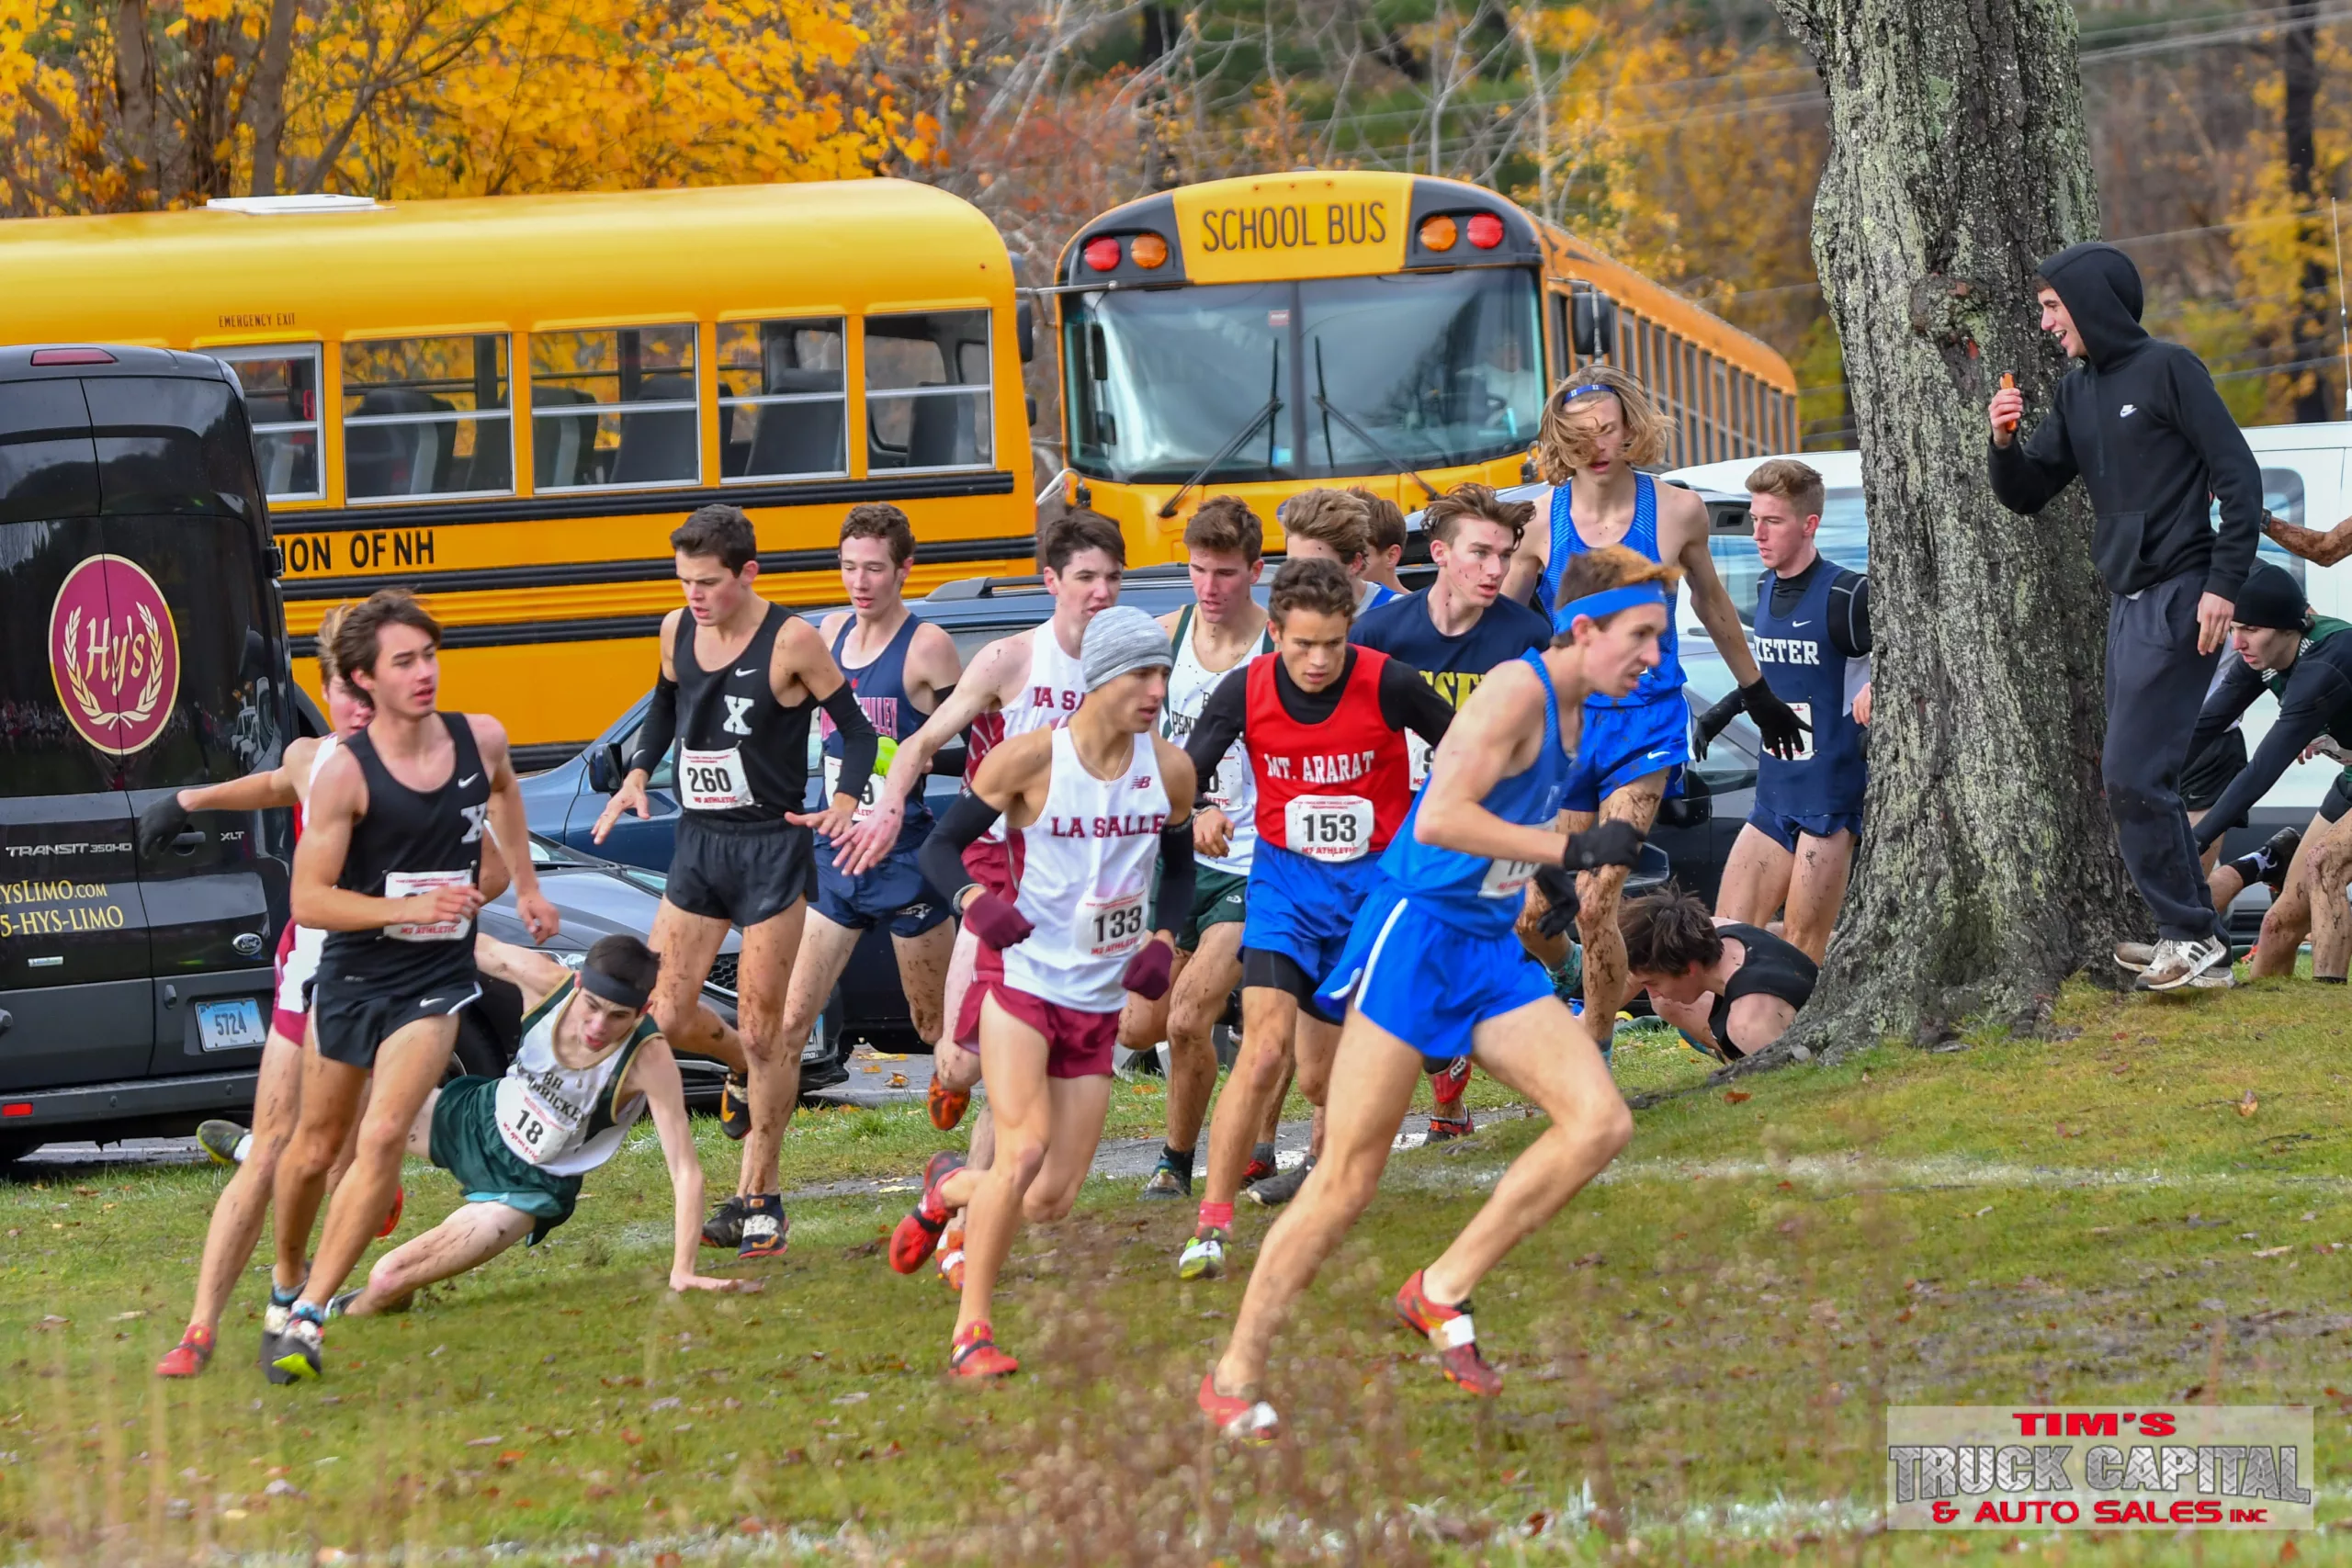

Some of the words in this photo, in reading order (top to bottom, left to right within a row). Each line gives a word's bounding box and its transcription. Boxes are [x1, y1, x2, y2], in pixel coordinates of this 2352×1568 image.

[1202, 205, 1317, 253] SCHOOL
[1328, 199, 1386, 245] BUS
[218, 313, 272, 328] EMERGENCY
[276, 311, 296, 326] EXIT
[349, 532, 387, 569] OF
[393, 528, 435, 567] NH
[85, 615, 146, 697] Hy's
[1753, 634, 1820, 666] XETER
[1032, 685, 1055, 708] LA
[722, 694, 755, 736] X
[686, 766, 733, 794] 260
[1263, 753, 1297, 780] MT.
[1302, 750, 1374, 784] ARARAT
[220, 830, 245, 841] XLT
[1050, 816, 1086, 839] LA
[1091, 812, 1167, 839] SALLE
[1302, 813, 1357, 842] 153
[6, 842, 89, 858] TRANSIT
[90, 841, 133, 853] 350HD
[1316, 846, 1359, 855] ATHLETIC
[414, 922, 458, 934] ATHLETIC
[1093, 905, 1142, 943] 133
[214, 1010, 247, 1035] 5724
[515, 1109, 544, 1145] 18
